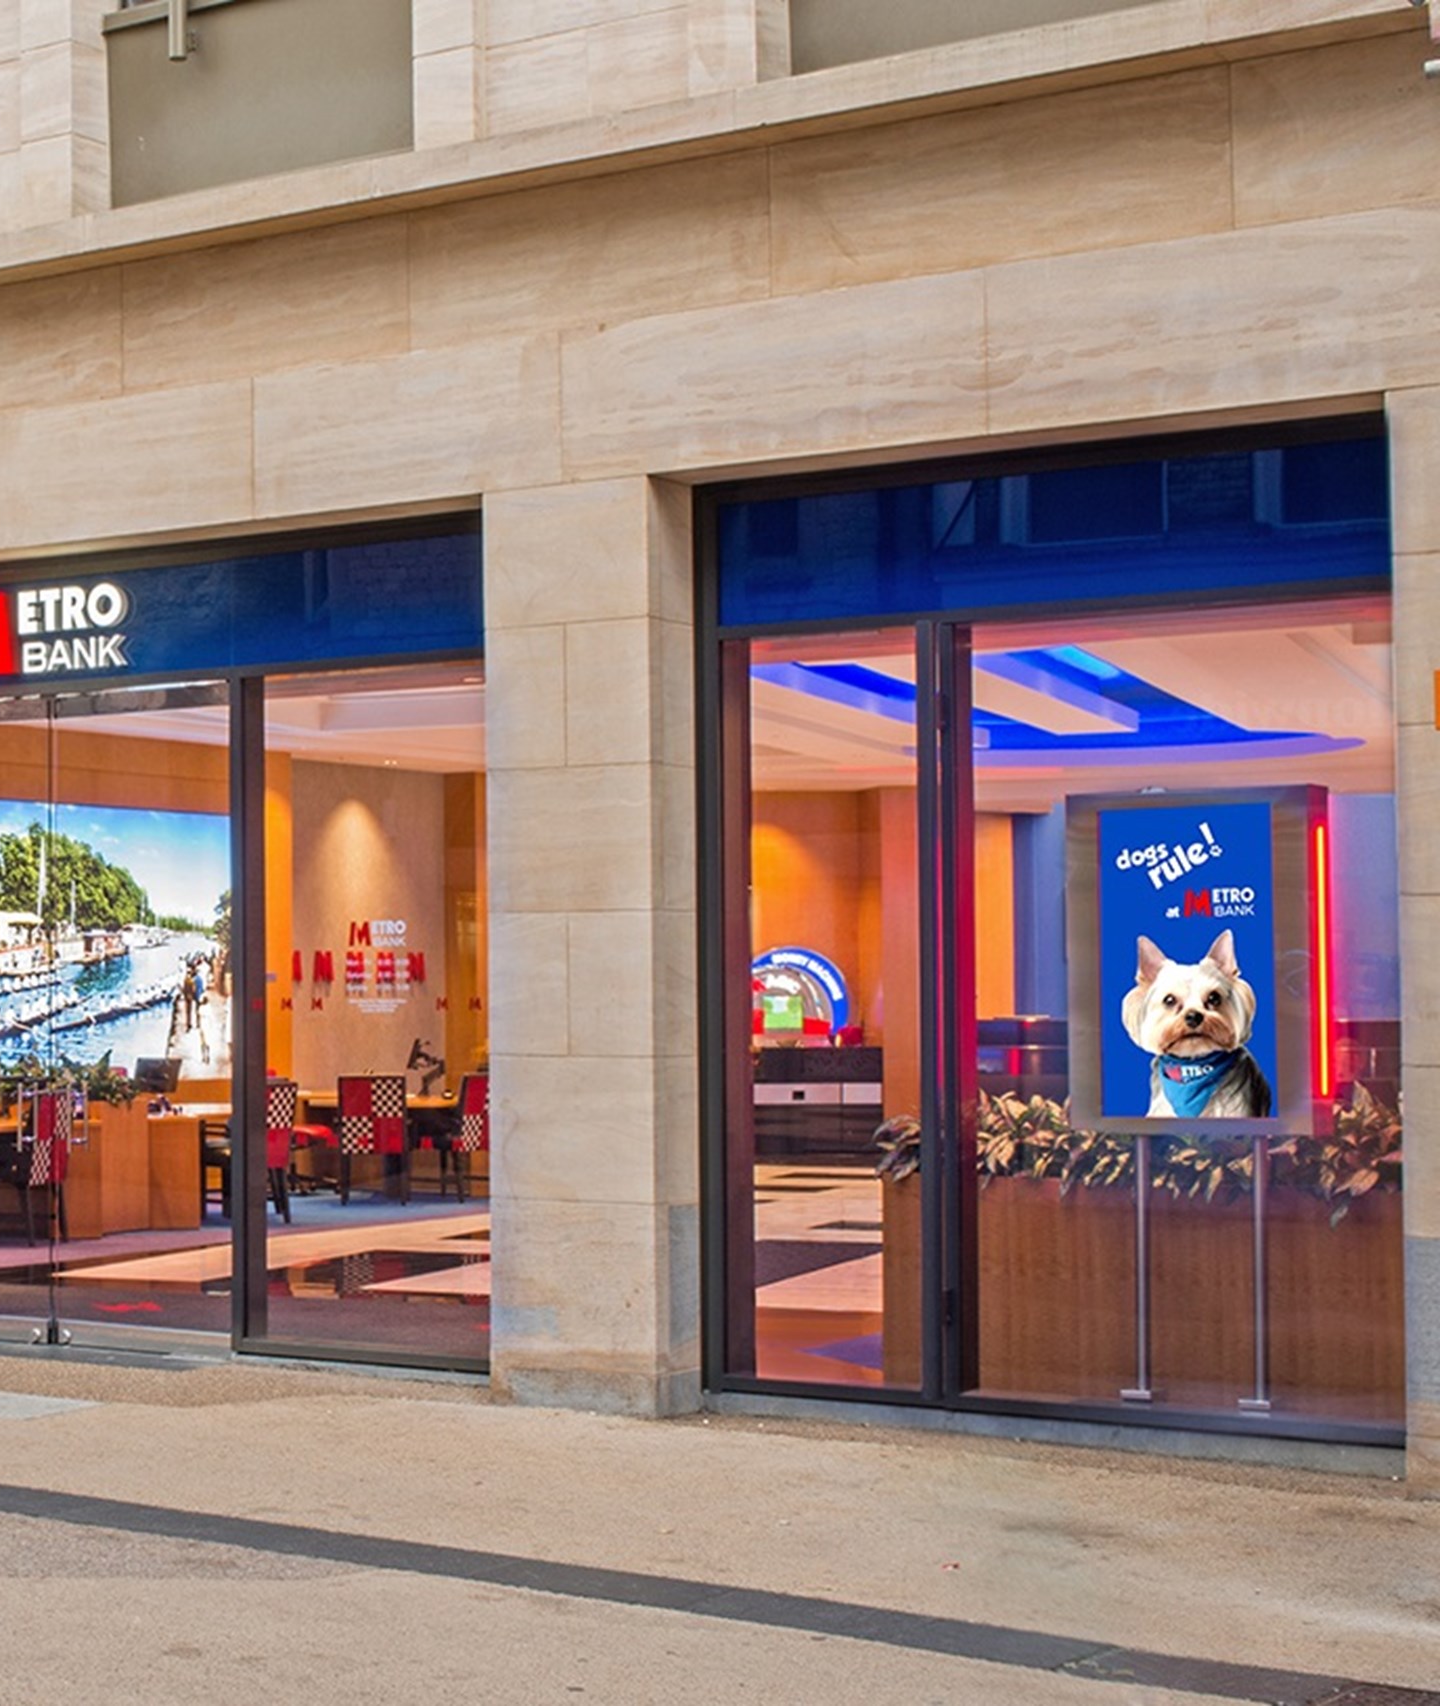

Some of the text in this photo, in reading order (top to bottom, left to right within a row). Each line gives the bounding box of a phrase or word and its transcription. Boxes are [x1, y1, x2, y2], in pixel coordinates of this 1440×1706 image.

[22, 634, 129, 674] BANK
[1116, 843, 1169, 870] dogs
[1147, 822, 1223, 890] rule!
[1165, 887, 1255, 918] at METRO
[1213, 904, 1256, 917] BANK
[349, 919, 406, 947] METRO
